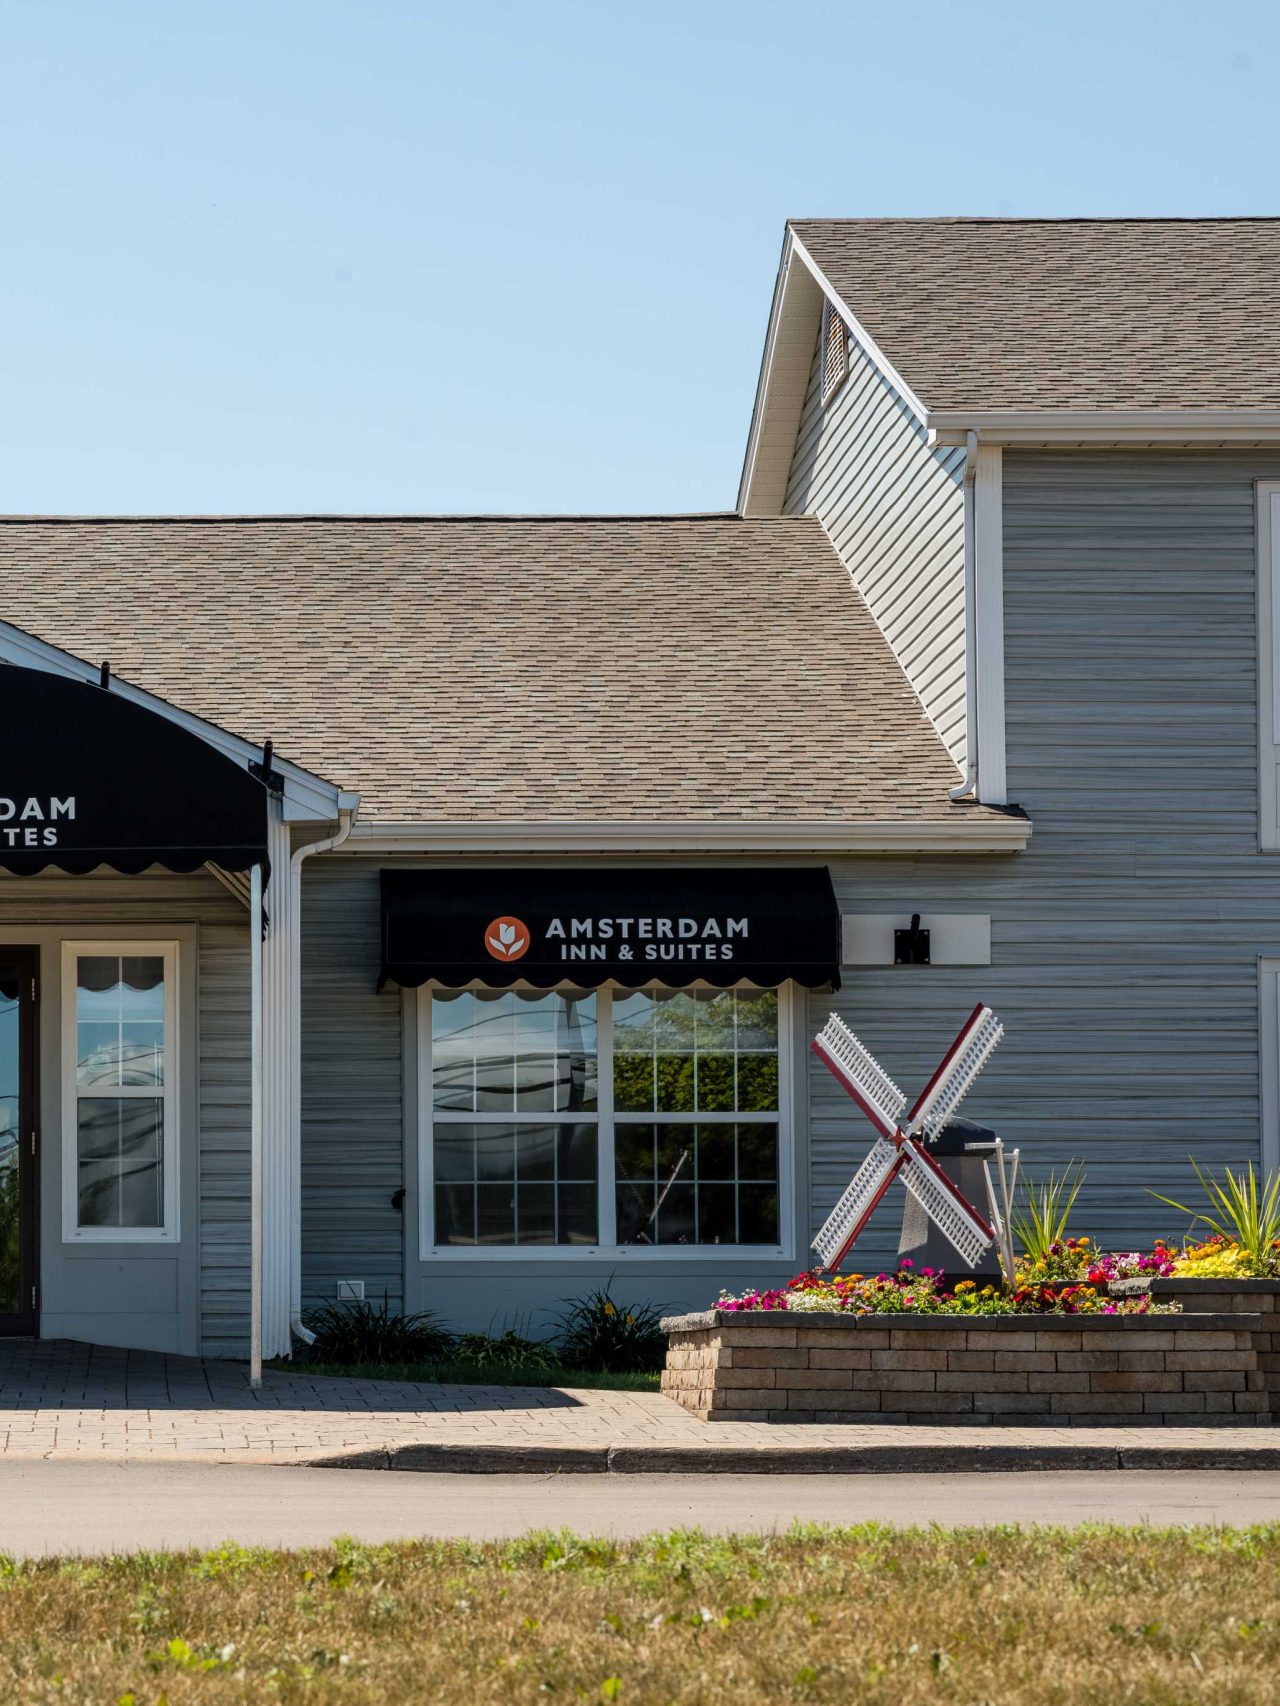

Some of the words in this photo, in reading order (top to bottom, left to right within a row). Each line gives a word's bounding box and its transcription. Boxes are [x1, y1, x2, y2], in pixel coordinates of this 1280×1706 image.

[544, 918, 749, 939] AMSTERDAM
[561, 944, 606, 960] INN
[618, 944, 634, 960] &
[645, 943, 733, 960] SUITES
